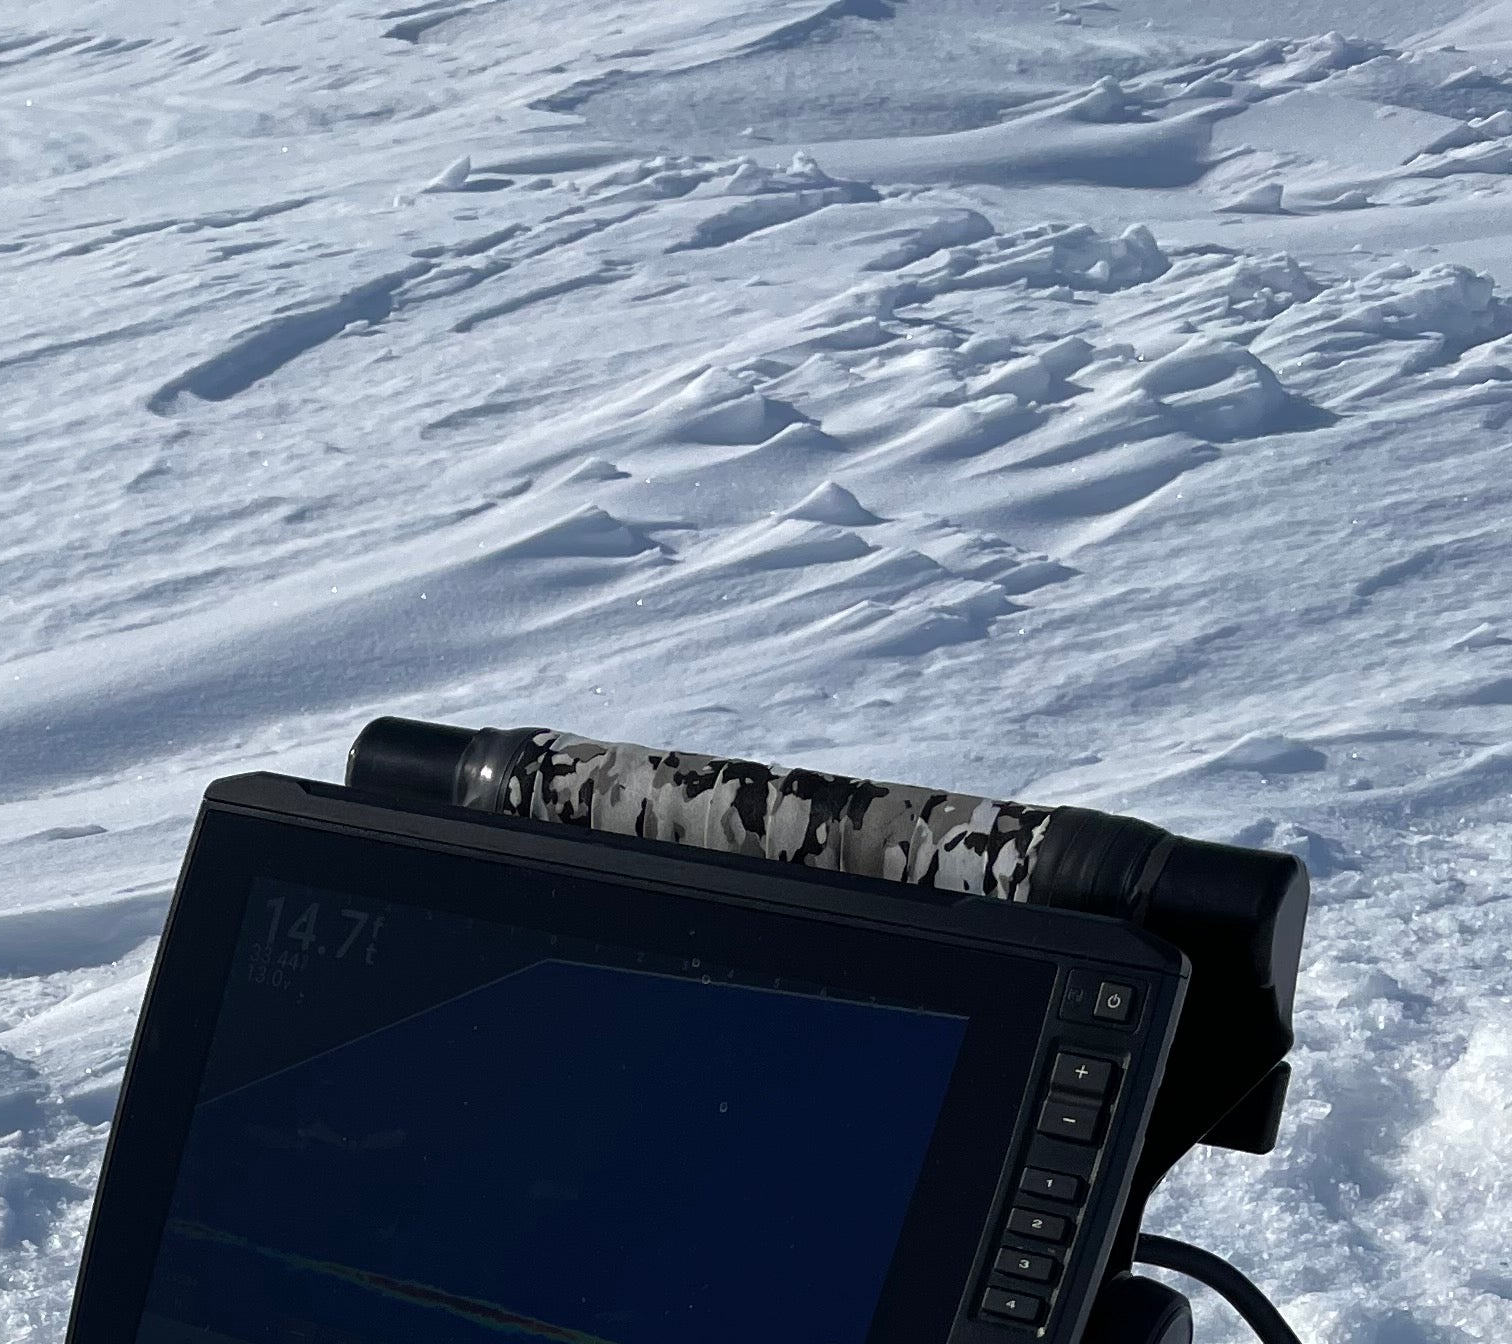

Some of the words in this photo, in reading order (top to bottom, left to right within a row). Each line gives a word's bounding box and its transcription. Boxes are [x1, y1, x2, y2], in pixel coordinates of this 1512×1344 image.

[266, 896, 369, 958] 14.7
[1046, 1178, 1054, 1189] 1
[1031, 1218, 1044, 1229] 2
[1018, 1258, 1031, 1270] 3
[1005, 1299, 1018, 1310] 4
